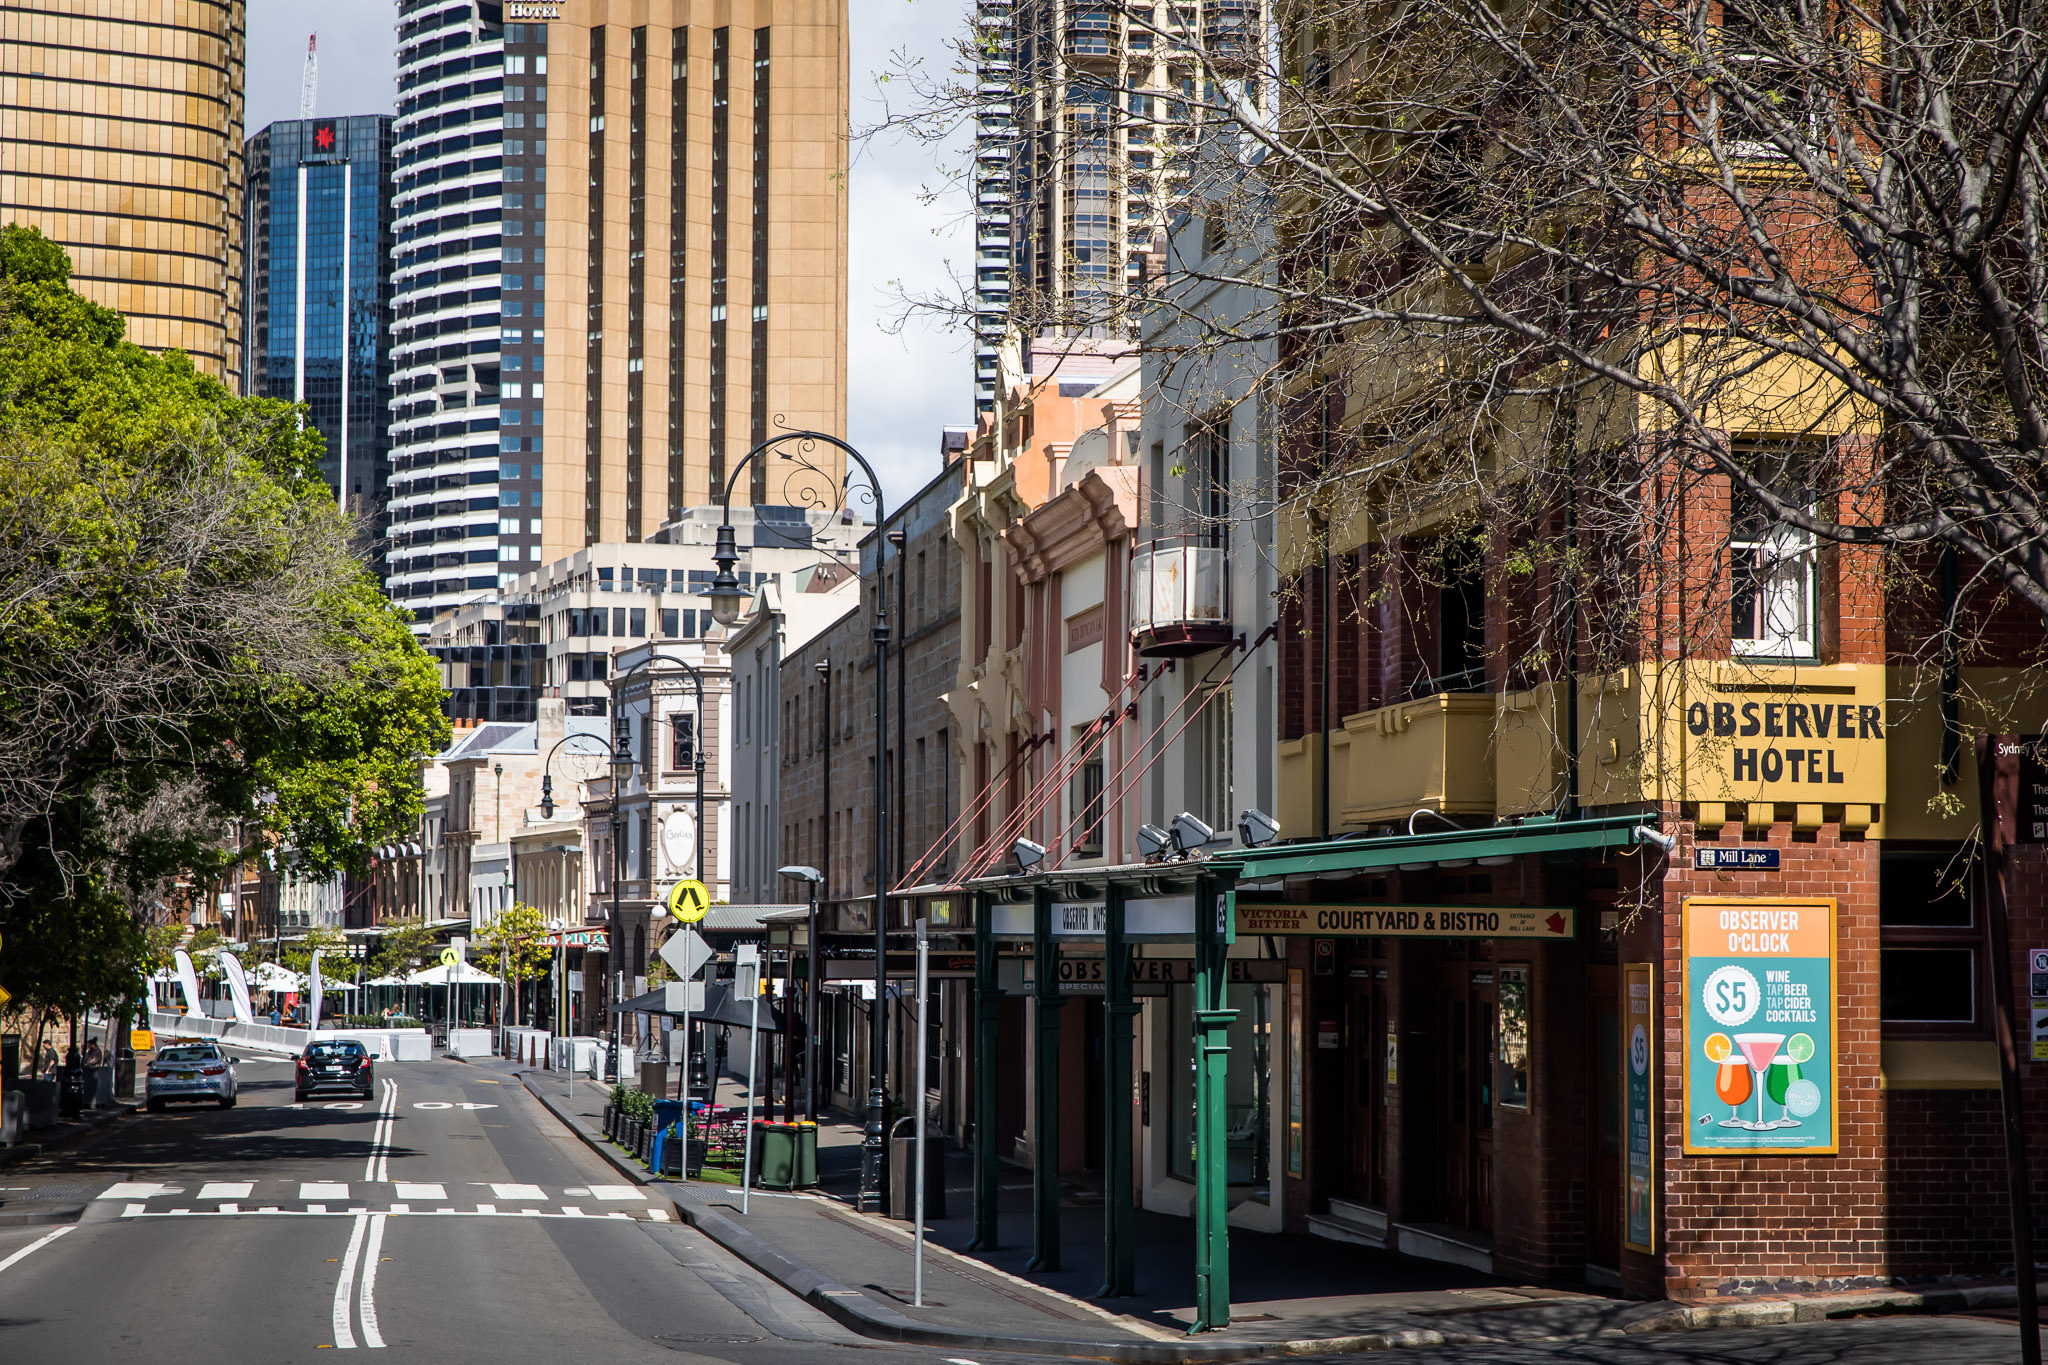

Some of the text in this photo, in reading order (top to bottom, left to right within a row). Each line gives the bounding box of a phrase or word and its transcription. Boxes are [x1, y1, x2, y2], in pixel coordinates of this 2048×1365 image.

[510, 4, 560, 19] HOTEL
[1687, 701, 1885, 740] OBSERVER
[1998, 742, 2030, 757] Sydney
[1733, 748, 1844, 784] HOTEL
[1719, 850, 1767, 864] Mill Lane
[1063, 906, 1106, 930] OBSERVER HOTE
[1240, 909, 1309, 920] VICTORIA
[1317, 910, 1500, 932] COURTYARD & BISTRO
[1719, 911, 1799, 931] OBSERVER
[1248, 919, 1301, 929] BITTER
[1728, 933, 1790, 953] O'CLOCK
[1060, 961, 1174, 980] OBSVER
[1766, 970, 1790, 983] WINE
[1715, 980, 1747, 1014] $5
[1766, 983, 1808, 996] TAP BEER
[1766, 997, 1811, 1009] TAP CIDER
[1766, 1009, 1816, 1022] COCKTAILS
[1635, 1036, 1645, 1065] $5
